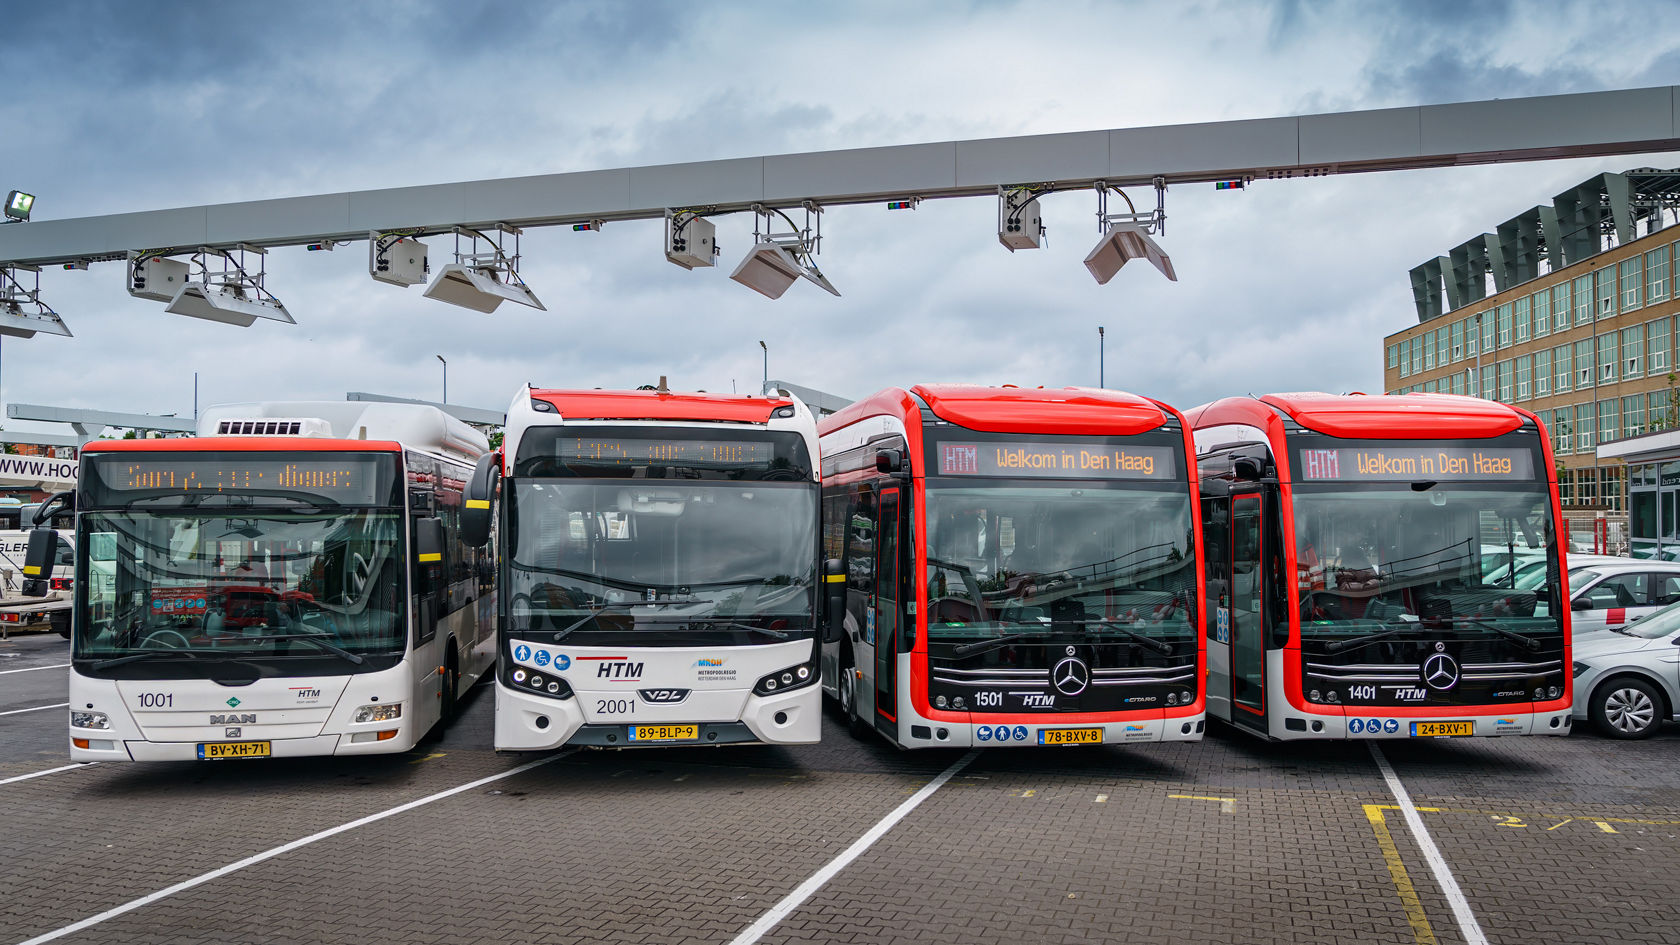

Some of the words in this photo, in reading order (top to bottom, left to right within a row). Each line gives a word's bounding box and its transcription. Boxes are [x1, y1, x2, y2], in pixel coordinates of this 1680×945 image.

[945, 447, 977, 472] HTM
[996, 448, 1056, 468] Welkom
[1062, 450, 1075, 468] in
[1080, 450, 1109, 470] Den
[1115, 451, 1154, 475] Haag
[1308, 449, 1340, 478] HTM
[1357, 452, 1416, 474] Welkom
[1421, 454, 1434, 474] in
[1439, 453, 1468, 474] Den
[1472, 452, 1512, 474] Haag
[597, 662, 644, 678] HTM
[298, 689, 320, 698] HTM
[645, 690, 681, 700] VDL
[974, 691, 1003, 706] 1501
[1348, 685, 1376, 700] 1401
[1394, 688, 1427, 700] HTM
[138, 692, 173, 708] 1001
[596, 699, 636, 714] 2001
[1023, 694, 1055, 706] HTM
[209, 713, 257, 725] MAN
[638, 726, 694, 739] 89-BLP-9
[1421, 723, 1468, 735] 24-BXV-1
[1047, 731, 1098, 743] 78-BXV-8
[211, 743, 264, 756] BV-XH-71
